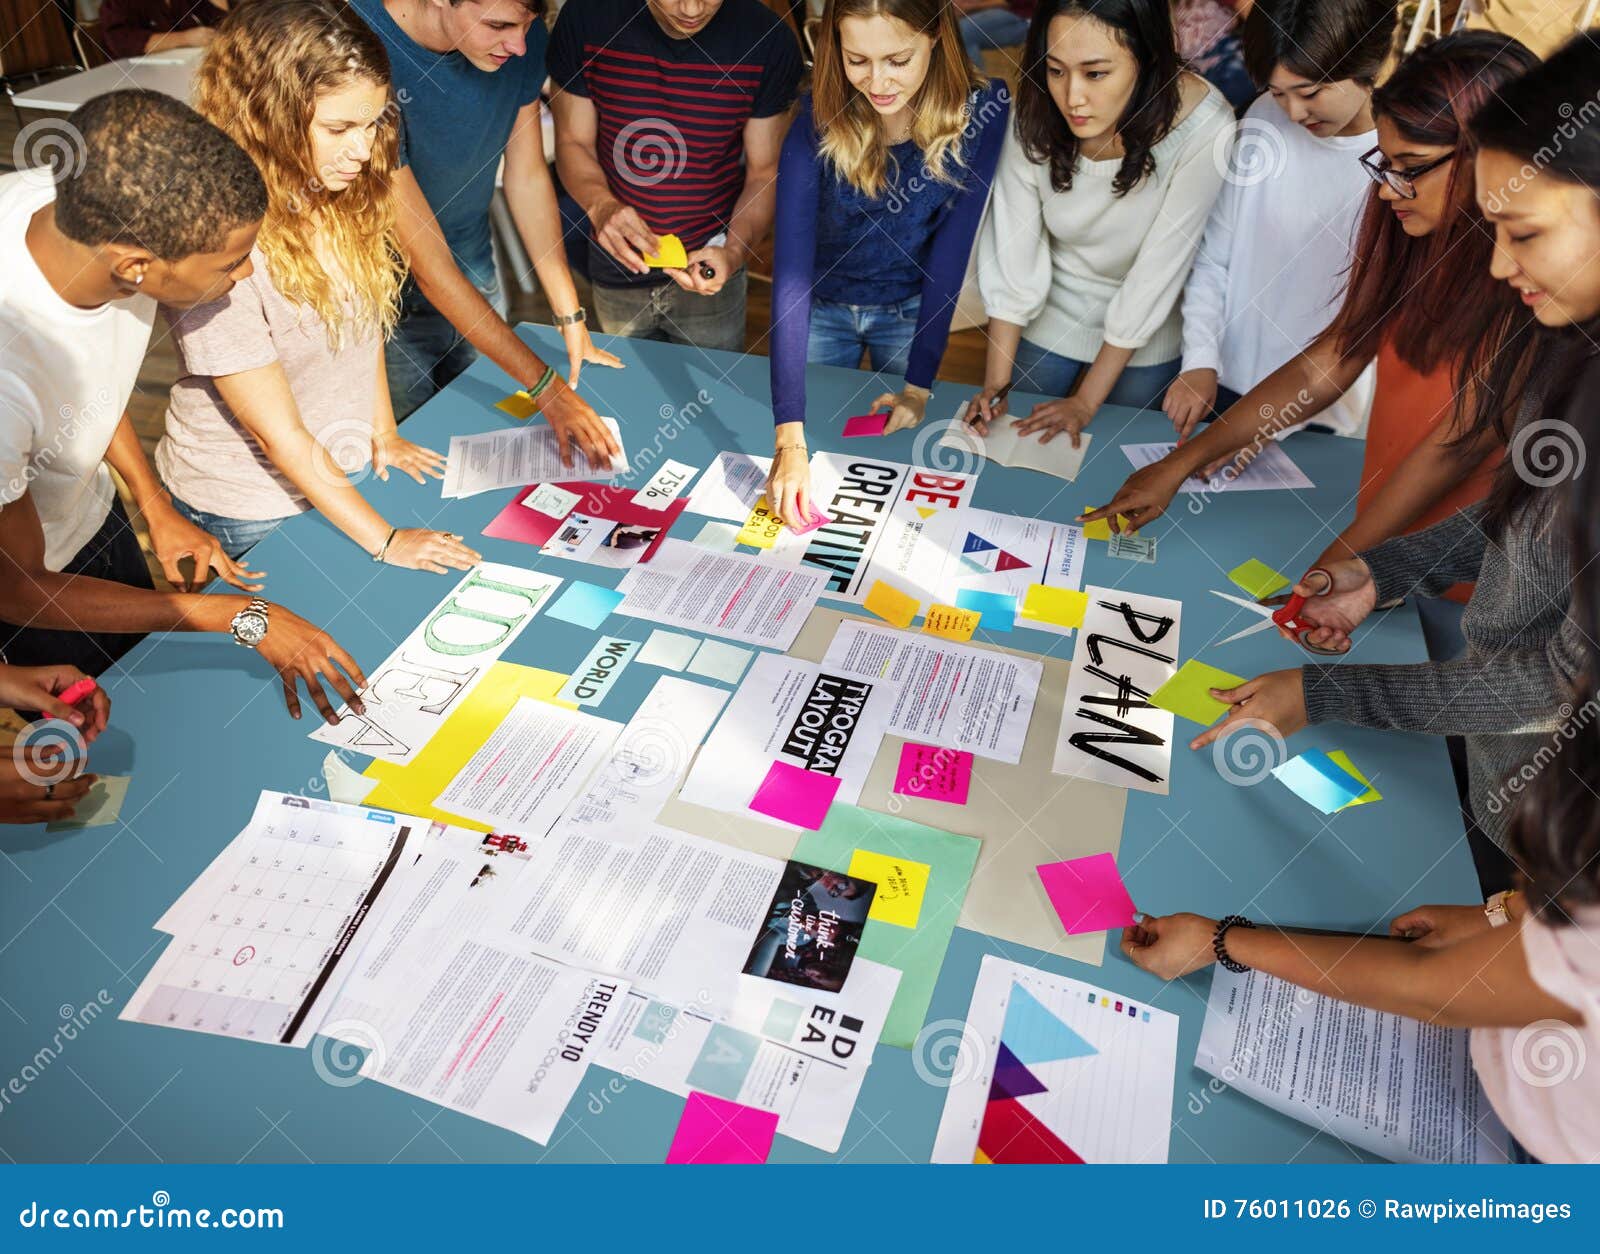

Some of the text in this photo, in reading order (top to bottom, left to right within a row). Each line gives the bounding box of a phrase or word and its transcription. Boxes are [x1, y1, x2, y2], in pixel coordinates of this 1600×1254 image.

[646, 470, 686, 498] 75%
[906, 473, 966, 508] BE
[764, 517, 783, 538] OOD
[1060, 528, 1077, 576] DEVELOPMENT
[320, 569, 551, 756] IDEA
[574, 641, 631, 699] WORLD
[1068, 600, 1176, 783] PLAN
[787, 679, 842, 760] LAYOUT
[784, 899, 804, 959] customer
[815, 909, 840, 950] think
[561, 983, 618, 1062] TRENDY 10
[527, 1048, 560, 1094] COLOUR
